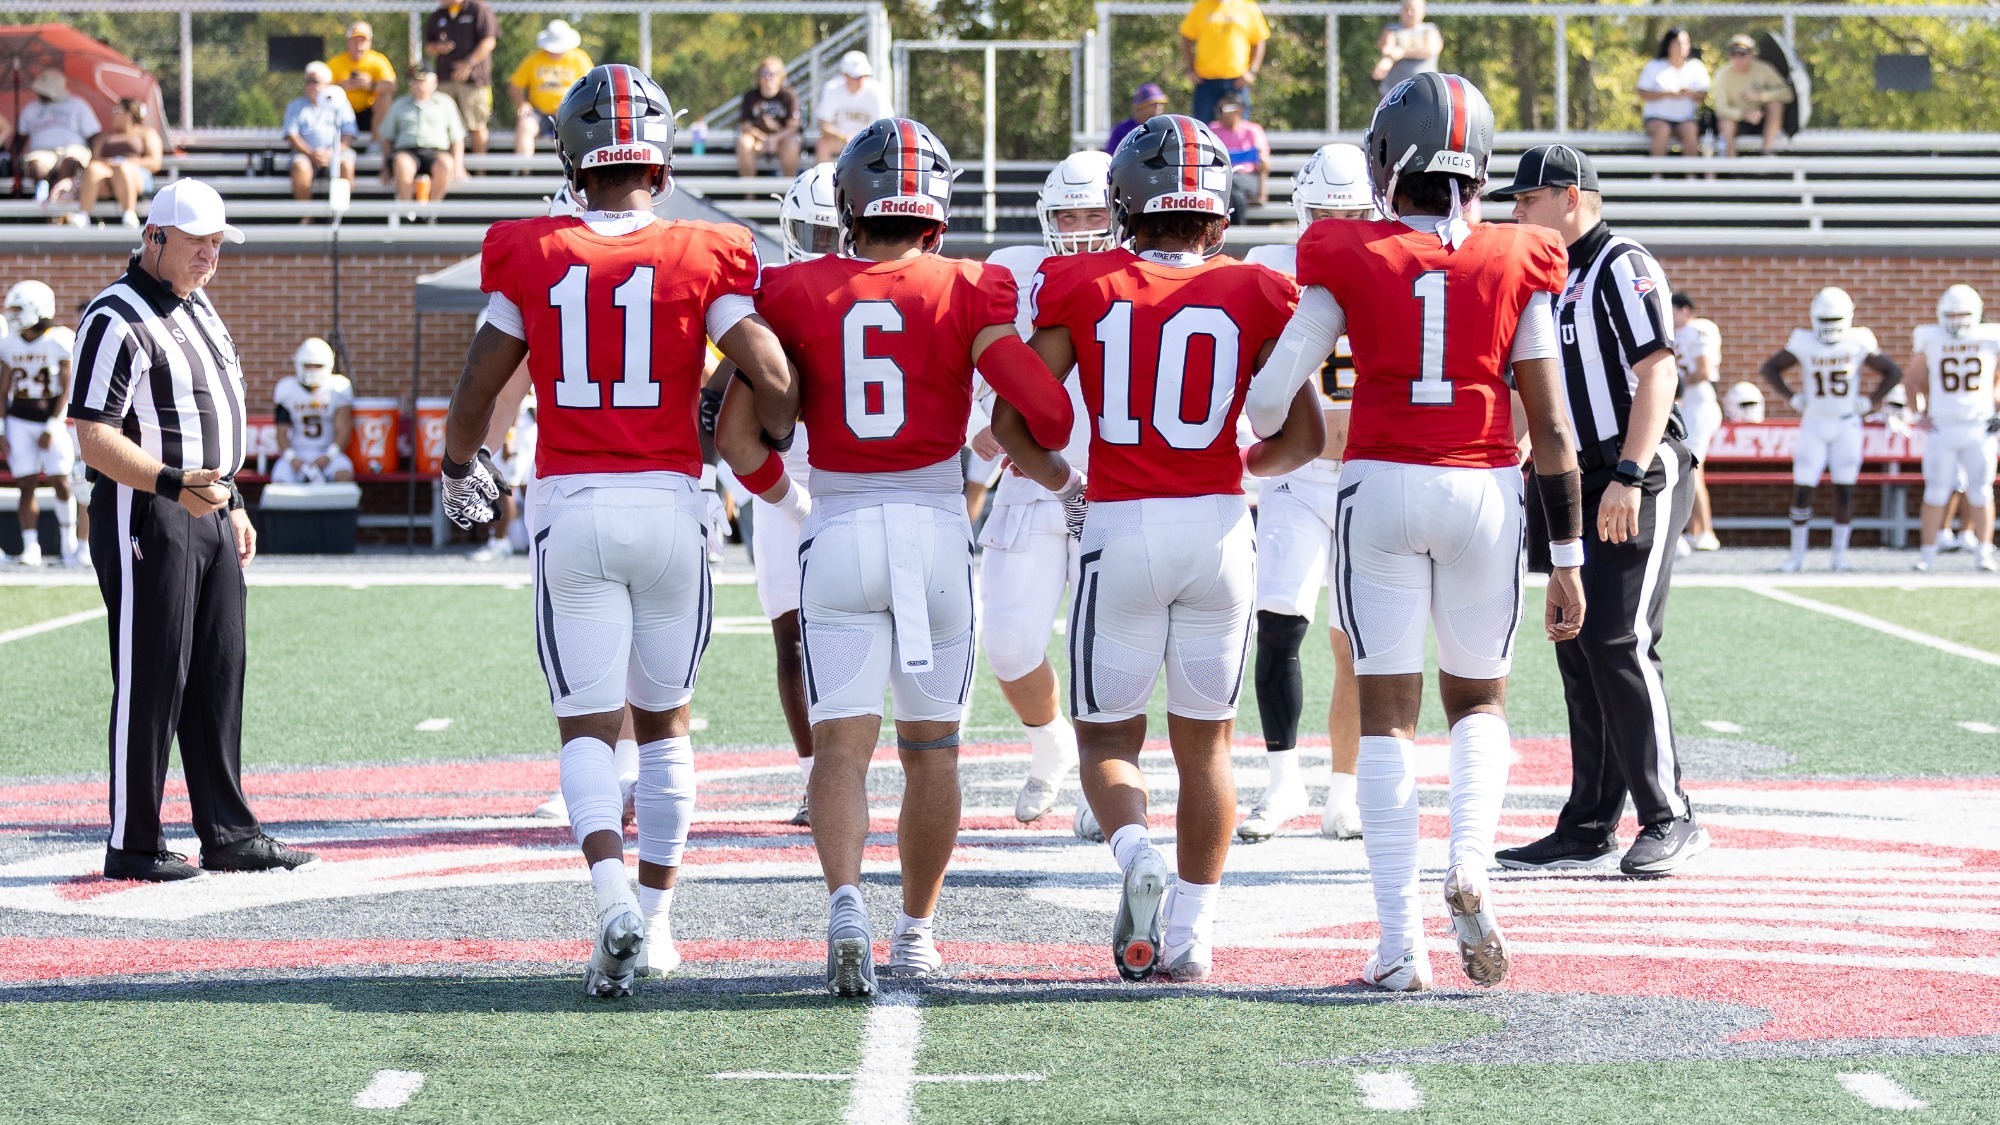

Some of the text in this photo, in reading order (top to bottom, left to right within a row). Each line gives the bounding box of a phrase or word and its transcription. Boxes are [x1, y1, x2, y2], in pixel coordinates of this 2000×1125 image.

[597, 149, 651, 163] Riddell
[1437, 155, 1471, 168] VICIS
[881, 200, 934, 215] Riddell
[1160, 196, 1214, 210] Riddell
[622, 211, 635, 219] PR
[1152, 252, 1169, 260] NIKE
[172, 327, 187, 345] S
[549, 264, 662, 410] 11
[1409, 269, 1455, 406] 1
[1561, 323, 1575, 345] U
[841, 299, 907, 441] 6
[1095, 299, 1242, 451] 10
[1941, 357, 1982, 391] 62
[10, 367, 51, 399] 24
[1813, 371, 1848, 397] 15
[302, 415, 322, 438] 5
